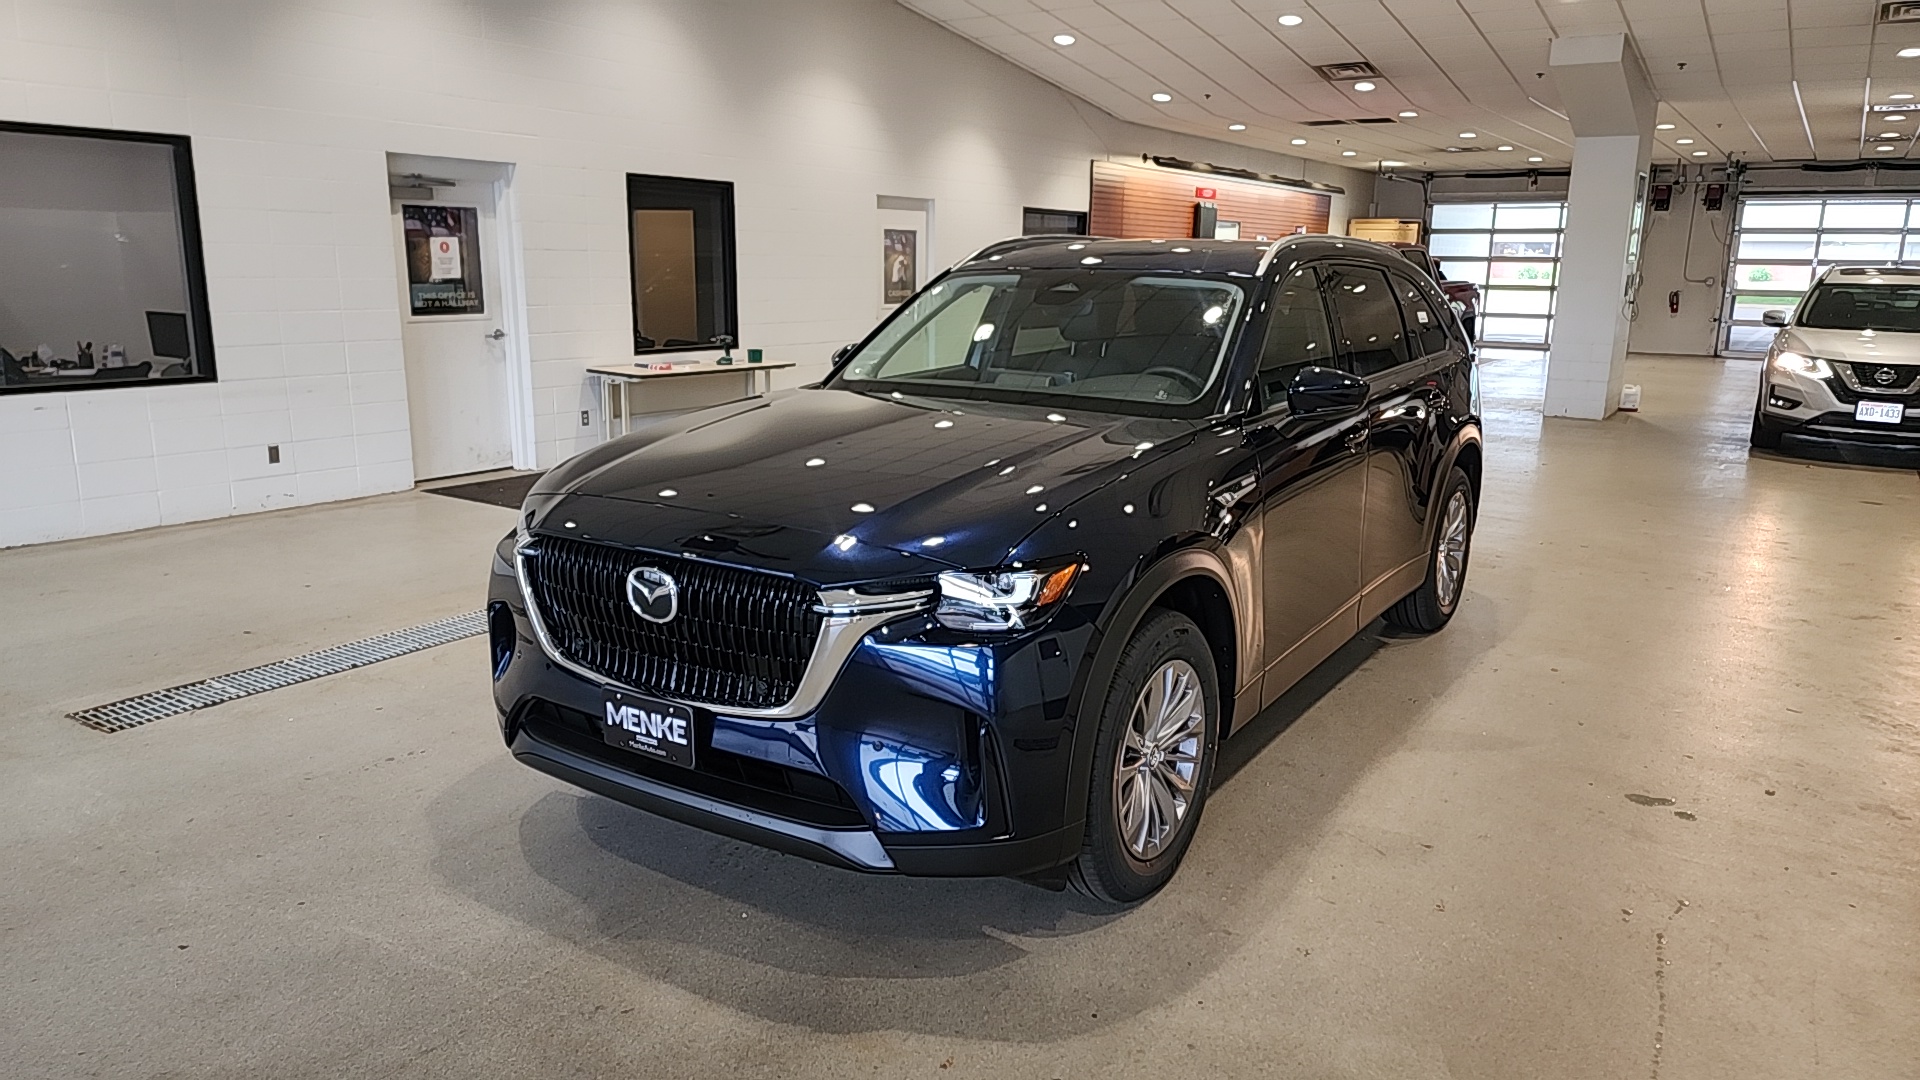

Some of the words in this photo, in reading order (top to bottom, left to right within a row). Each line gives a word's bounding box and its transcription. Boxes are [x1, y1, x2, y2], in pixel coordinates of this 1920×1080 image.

[438, 291, 466, 299] OFFICE
[414, 300, 432, 308] NOT
[441, 299, 479, 307] HALLWAY
[1859, 407, 1900, 418] AXD-1433
[606, 702, 687, 745] MENKE
